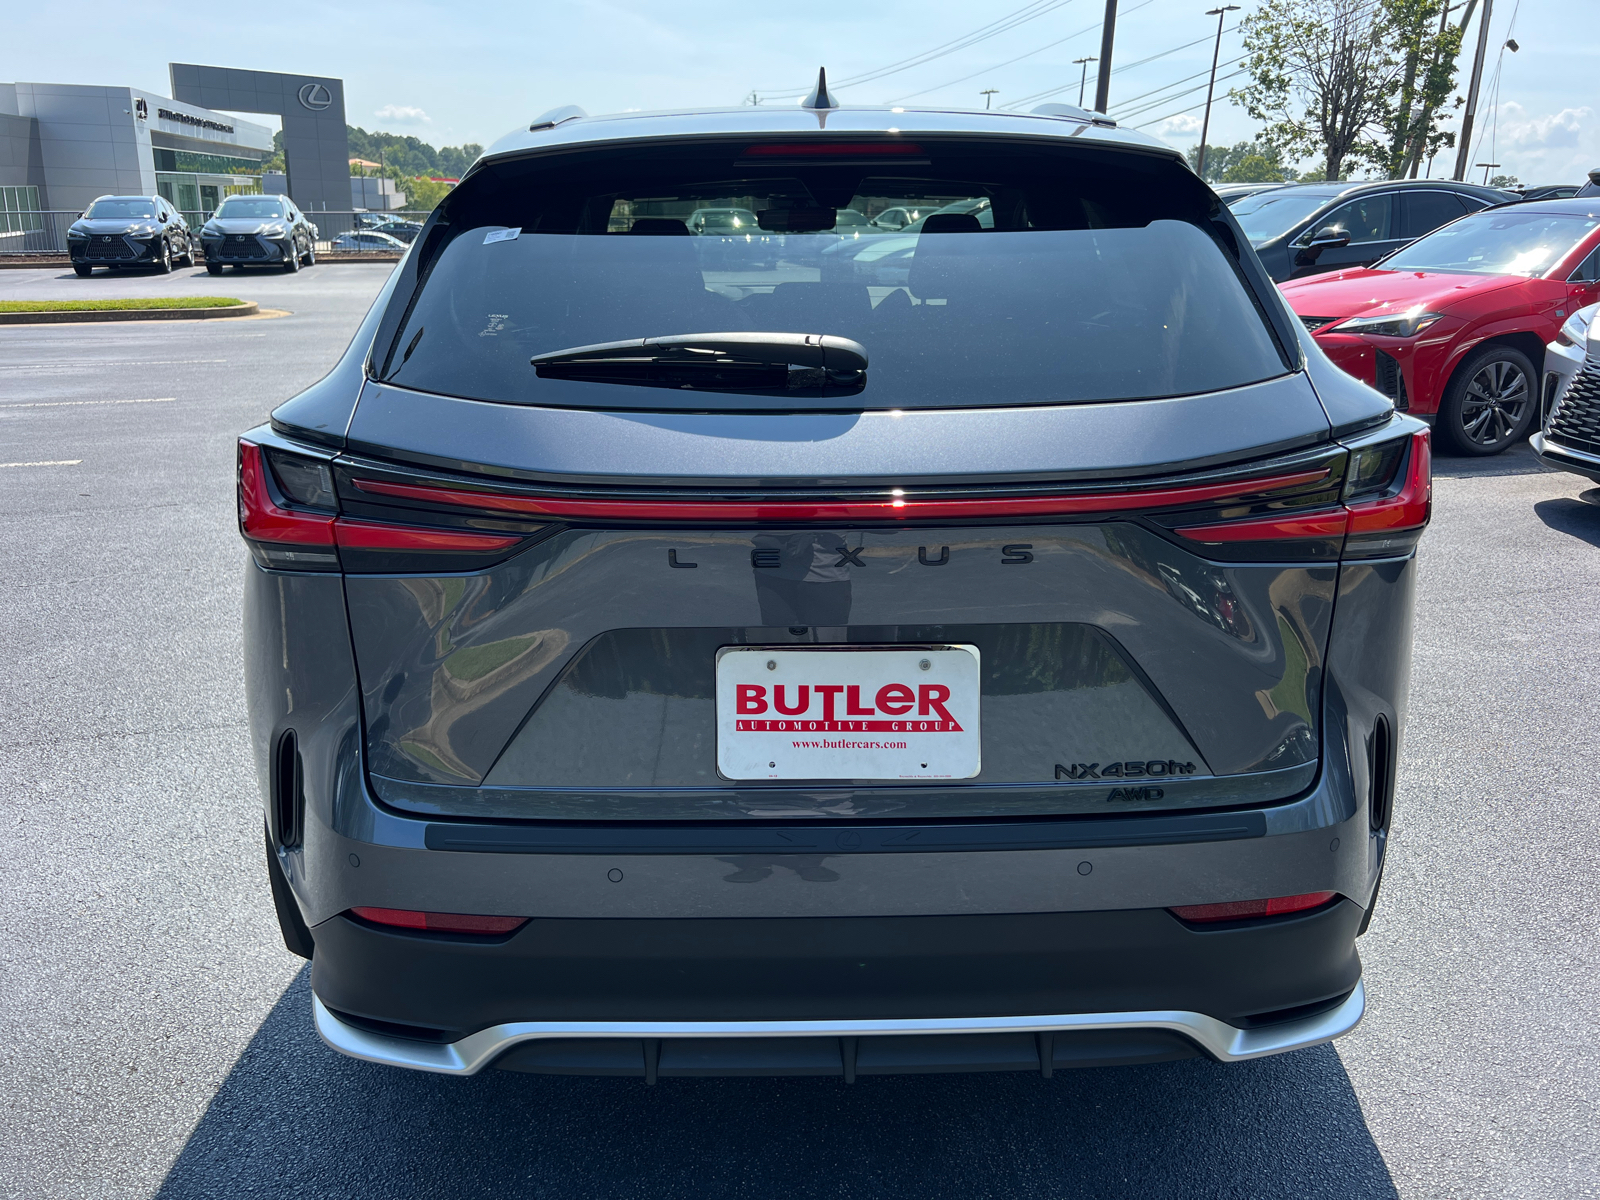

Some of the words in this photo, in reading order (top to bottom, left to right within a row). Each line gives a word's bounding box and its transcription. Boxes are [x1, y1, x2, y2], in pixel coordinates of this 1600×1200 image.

[668, 544, 1034, 568] LEXUS
[737, 720, 869, 731] AUTOMOTIVE
[891, 720, 956, 731] GROUP
[792, 738, 907, 749] www.butlercars.com
[1107, 786, 1165, 802] AWD
